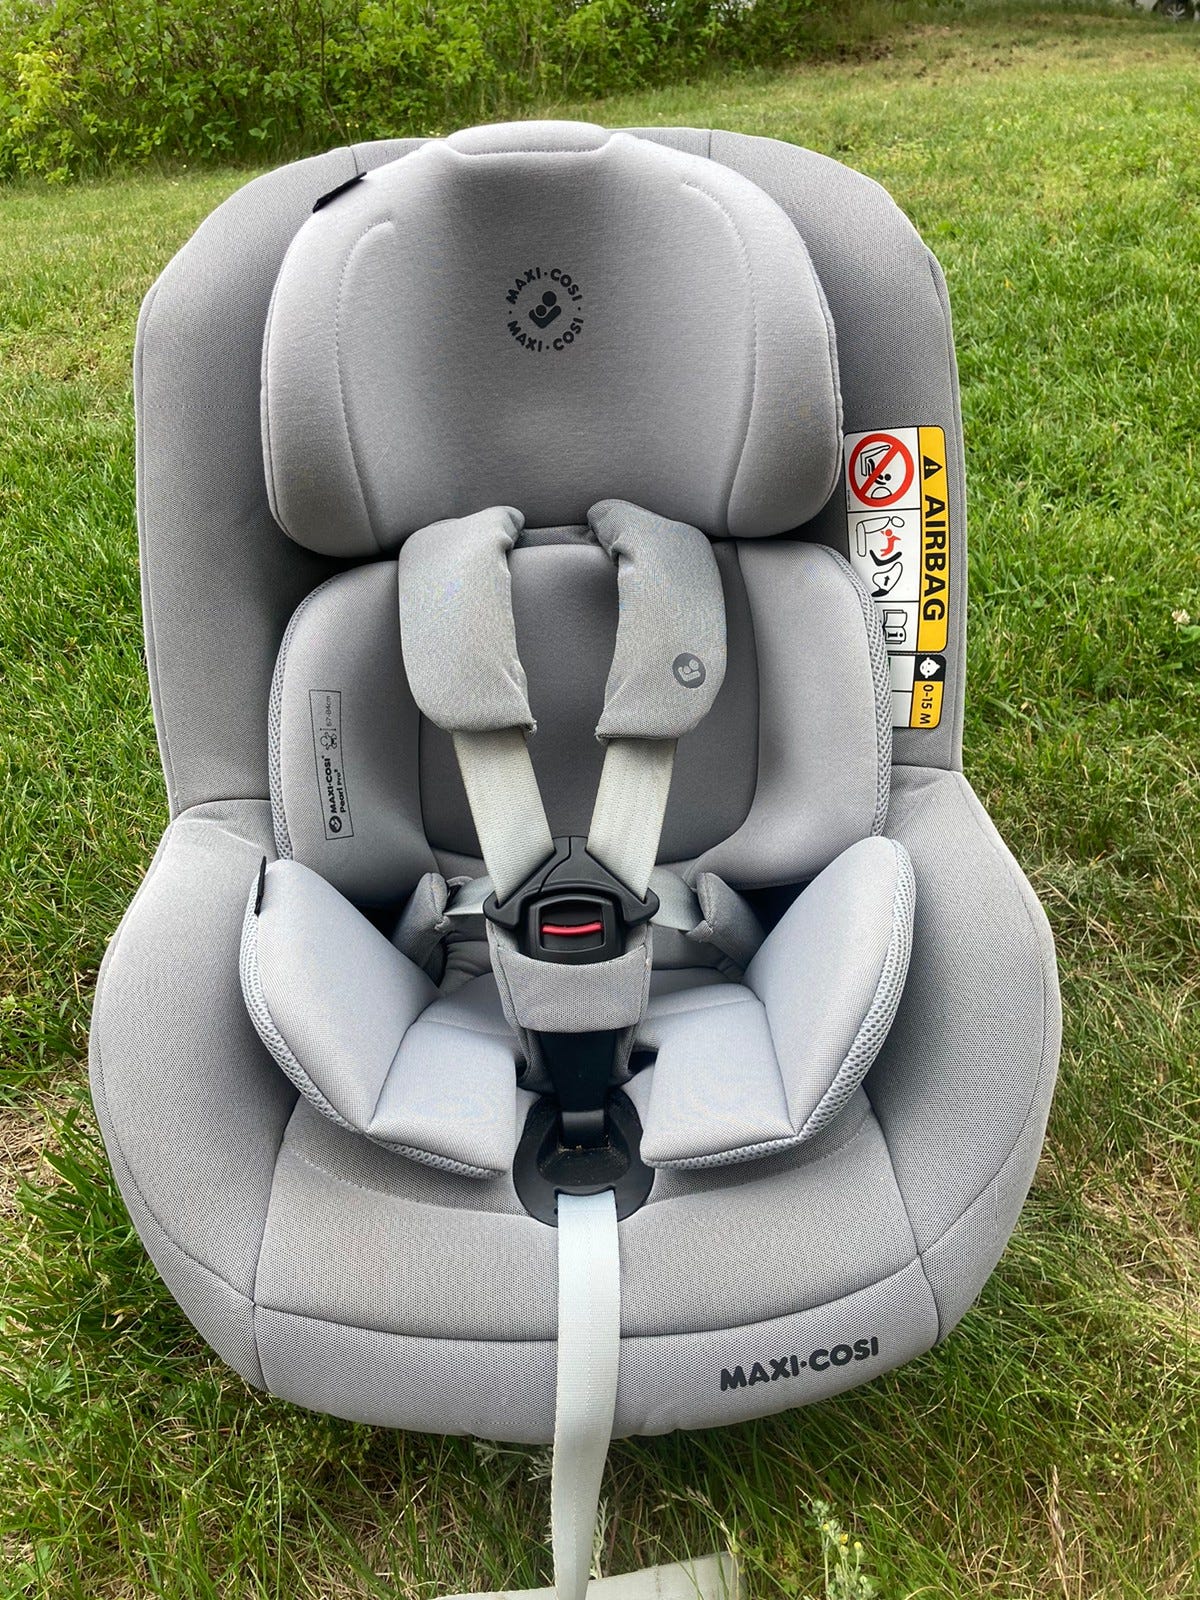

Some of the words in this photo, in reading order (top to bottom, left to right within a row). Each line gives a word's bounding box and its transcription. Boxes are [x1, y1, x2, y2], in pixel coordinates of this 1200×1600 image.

[922, 494, 947, 622] AIRBAG
[921, 684, 934, 709] 0-15
[919, 713, 931, 724] M
[336, 787, 346, 813] Pearl
